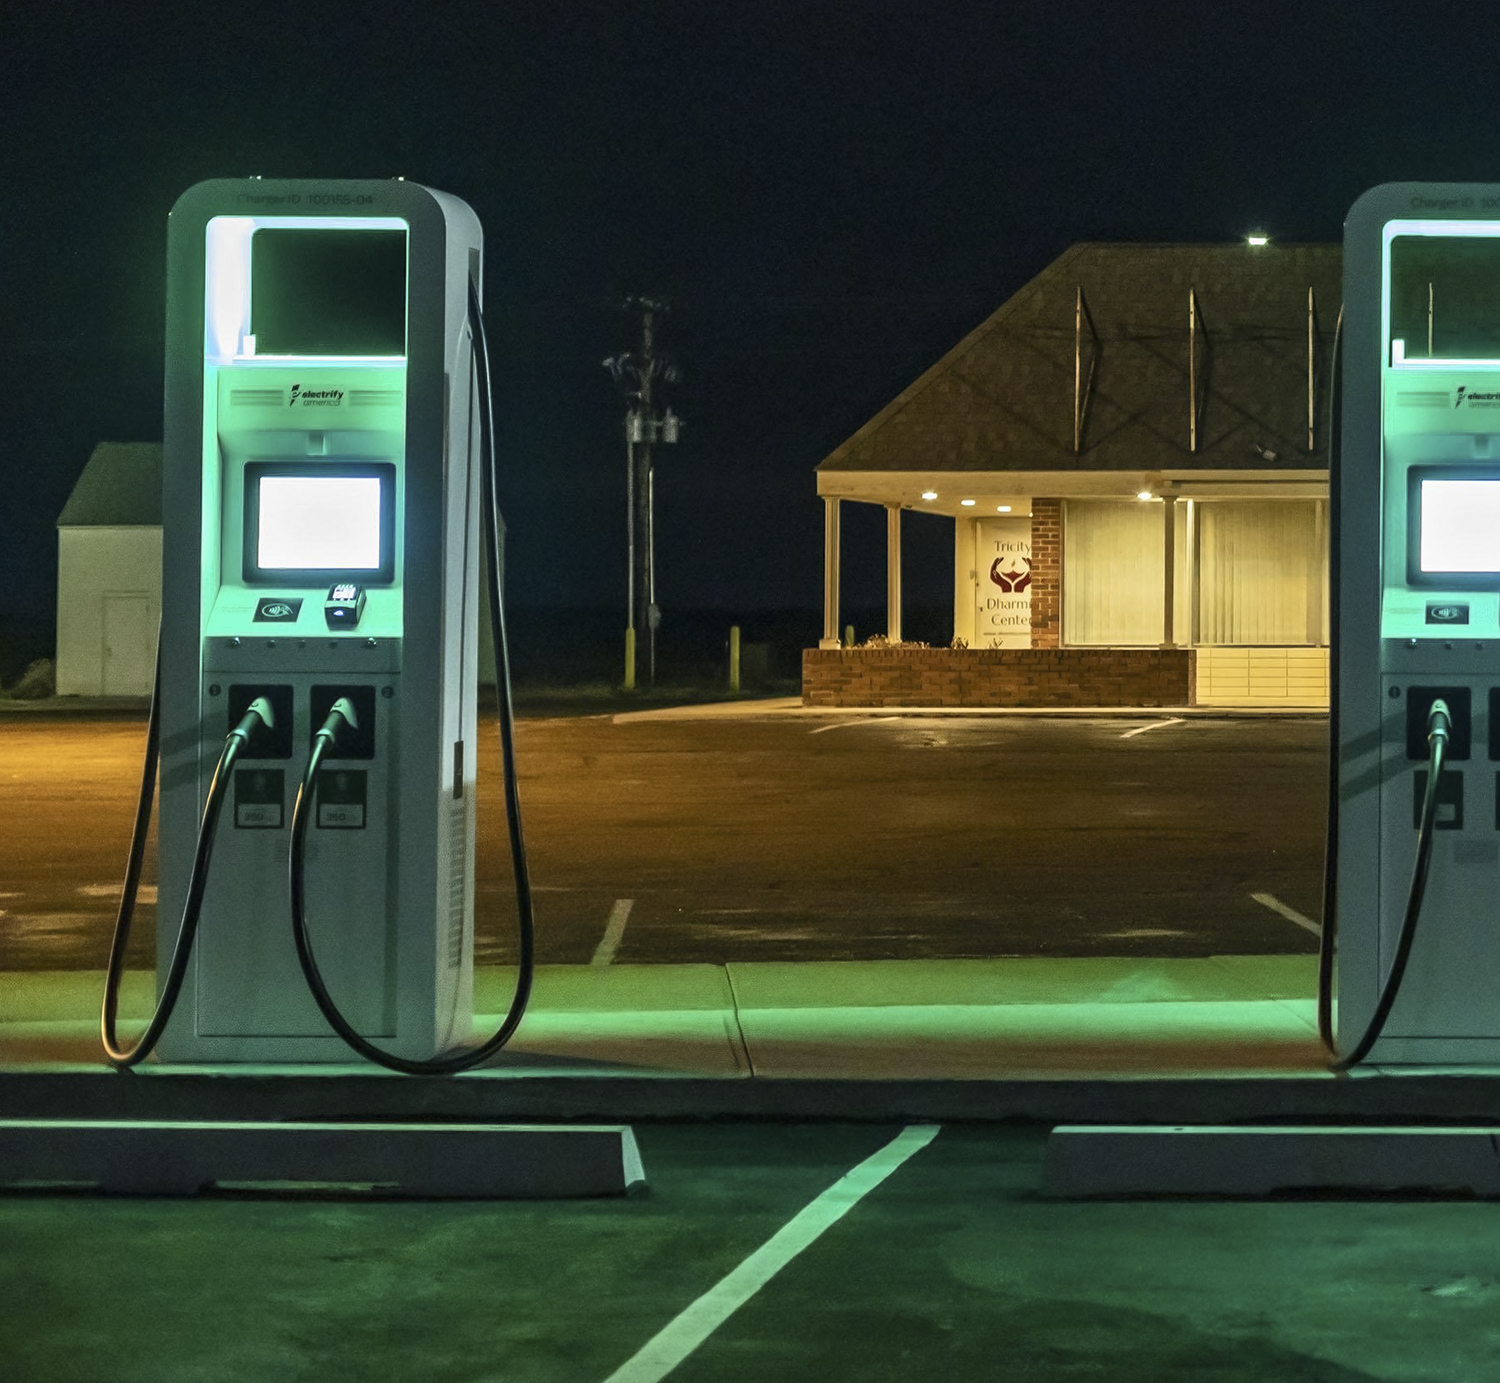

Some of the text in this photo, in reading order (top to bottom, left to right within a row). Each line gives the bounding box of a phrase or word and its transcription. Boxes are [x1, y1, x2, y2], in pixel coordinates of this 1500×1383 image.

[237, 193, 284, 206] Charger
[1411, 196, 1459, 209] Charger
[302, 390, 344, 400] electrify
[994, 540, 1031, 554] Tricity
[986, 598, 1031, 610] Dharm
